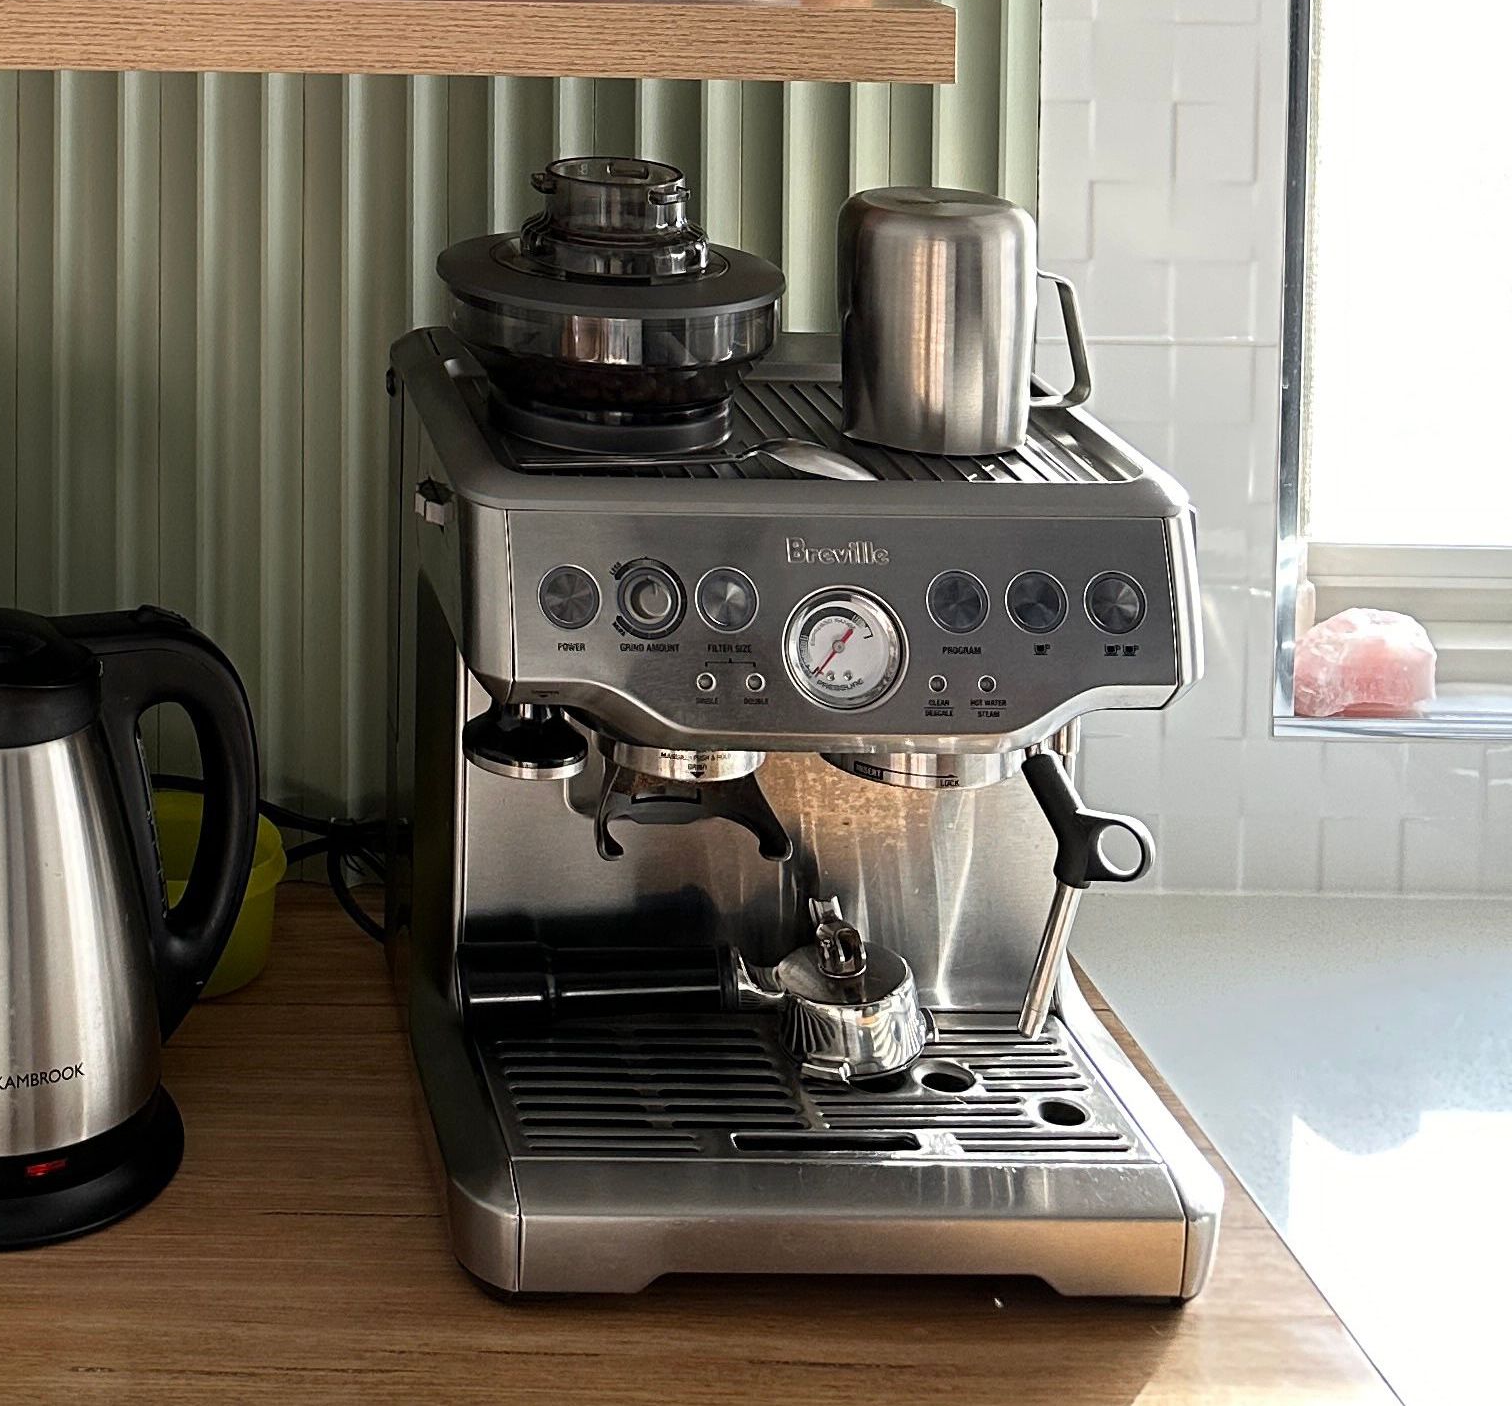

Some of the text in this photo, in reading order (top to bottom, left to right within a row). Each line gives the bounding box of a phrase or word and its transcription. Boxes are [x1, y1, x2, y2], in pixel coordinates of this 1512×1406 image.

[785, 537, 890, 565] Breville
[557, 642, 586, 652] POWER
[619, 643, 680, 653] GRIND AMOUNT
[708, 644, 752, 653] FILTER SIZE
[942, 646, 981, 655] PROGRAM
[940, 779, 960, 787] LOCK
